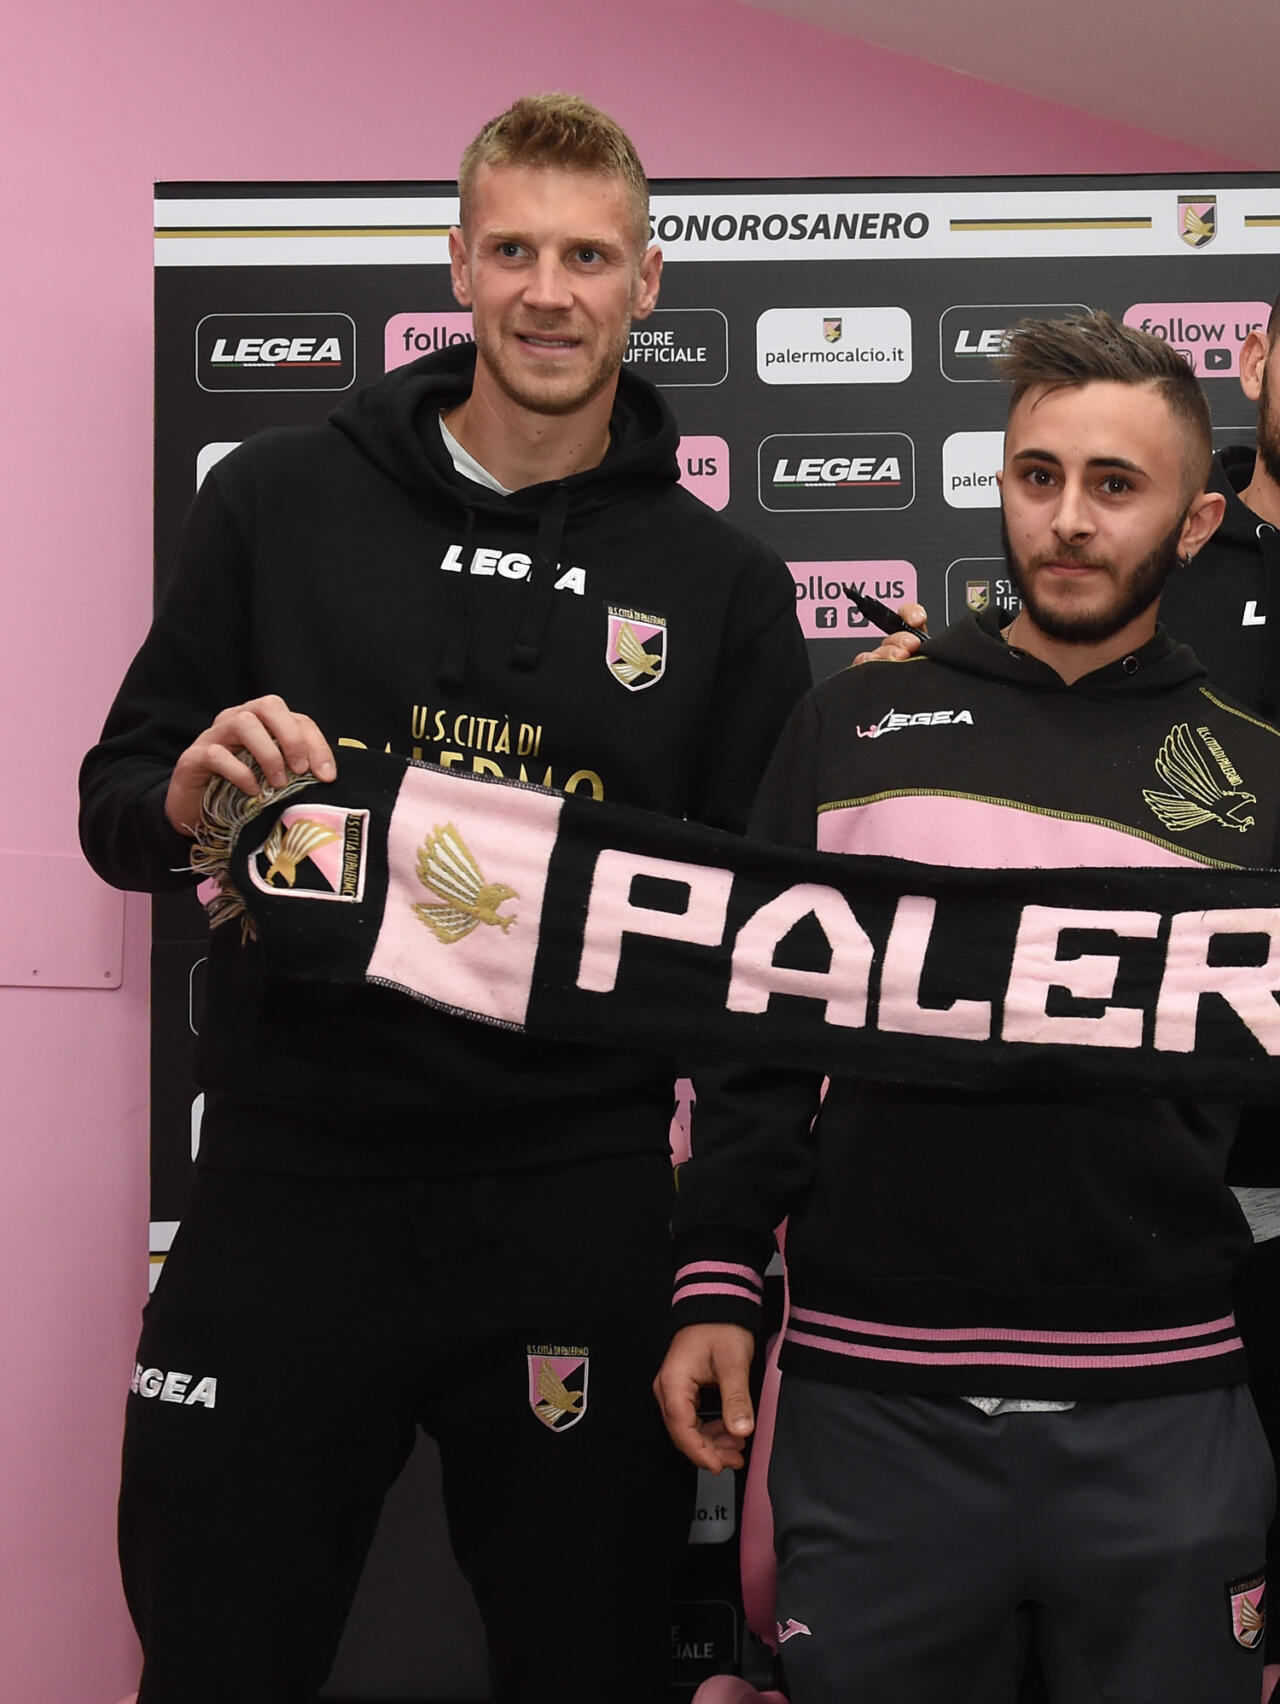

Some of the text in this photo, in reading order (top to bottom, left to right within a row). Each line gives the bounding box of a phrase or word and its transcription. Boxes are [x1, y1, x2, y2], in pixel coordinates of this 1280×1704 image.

[1140, 318, 1225, 342] follow
[211, 338, 341, 362] LEGEA
[766, 347, 905, 366] palermocalcio.it
[687, 457, 717, 476] us
[773, 457, 901, 482] LEGEA
[875, 580, 905, 599] us
[517, 723, 542, 757] DI
